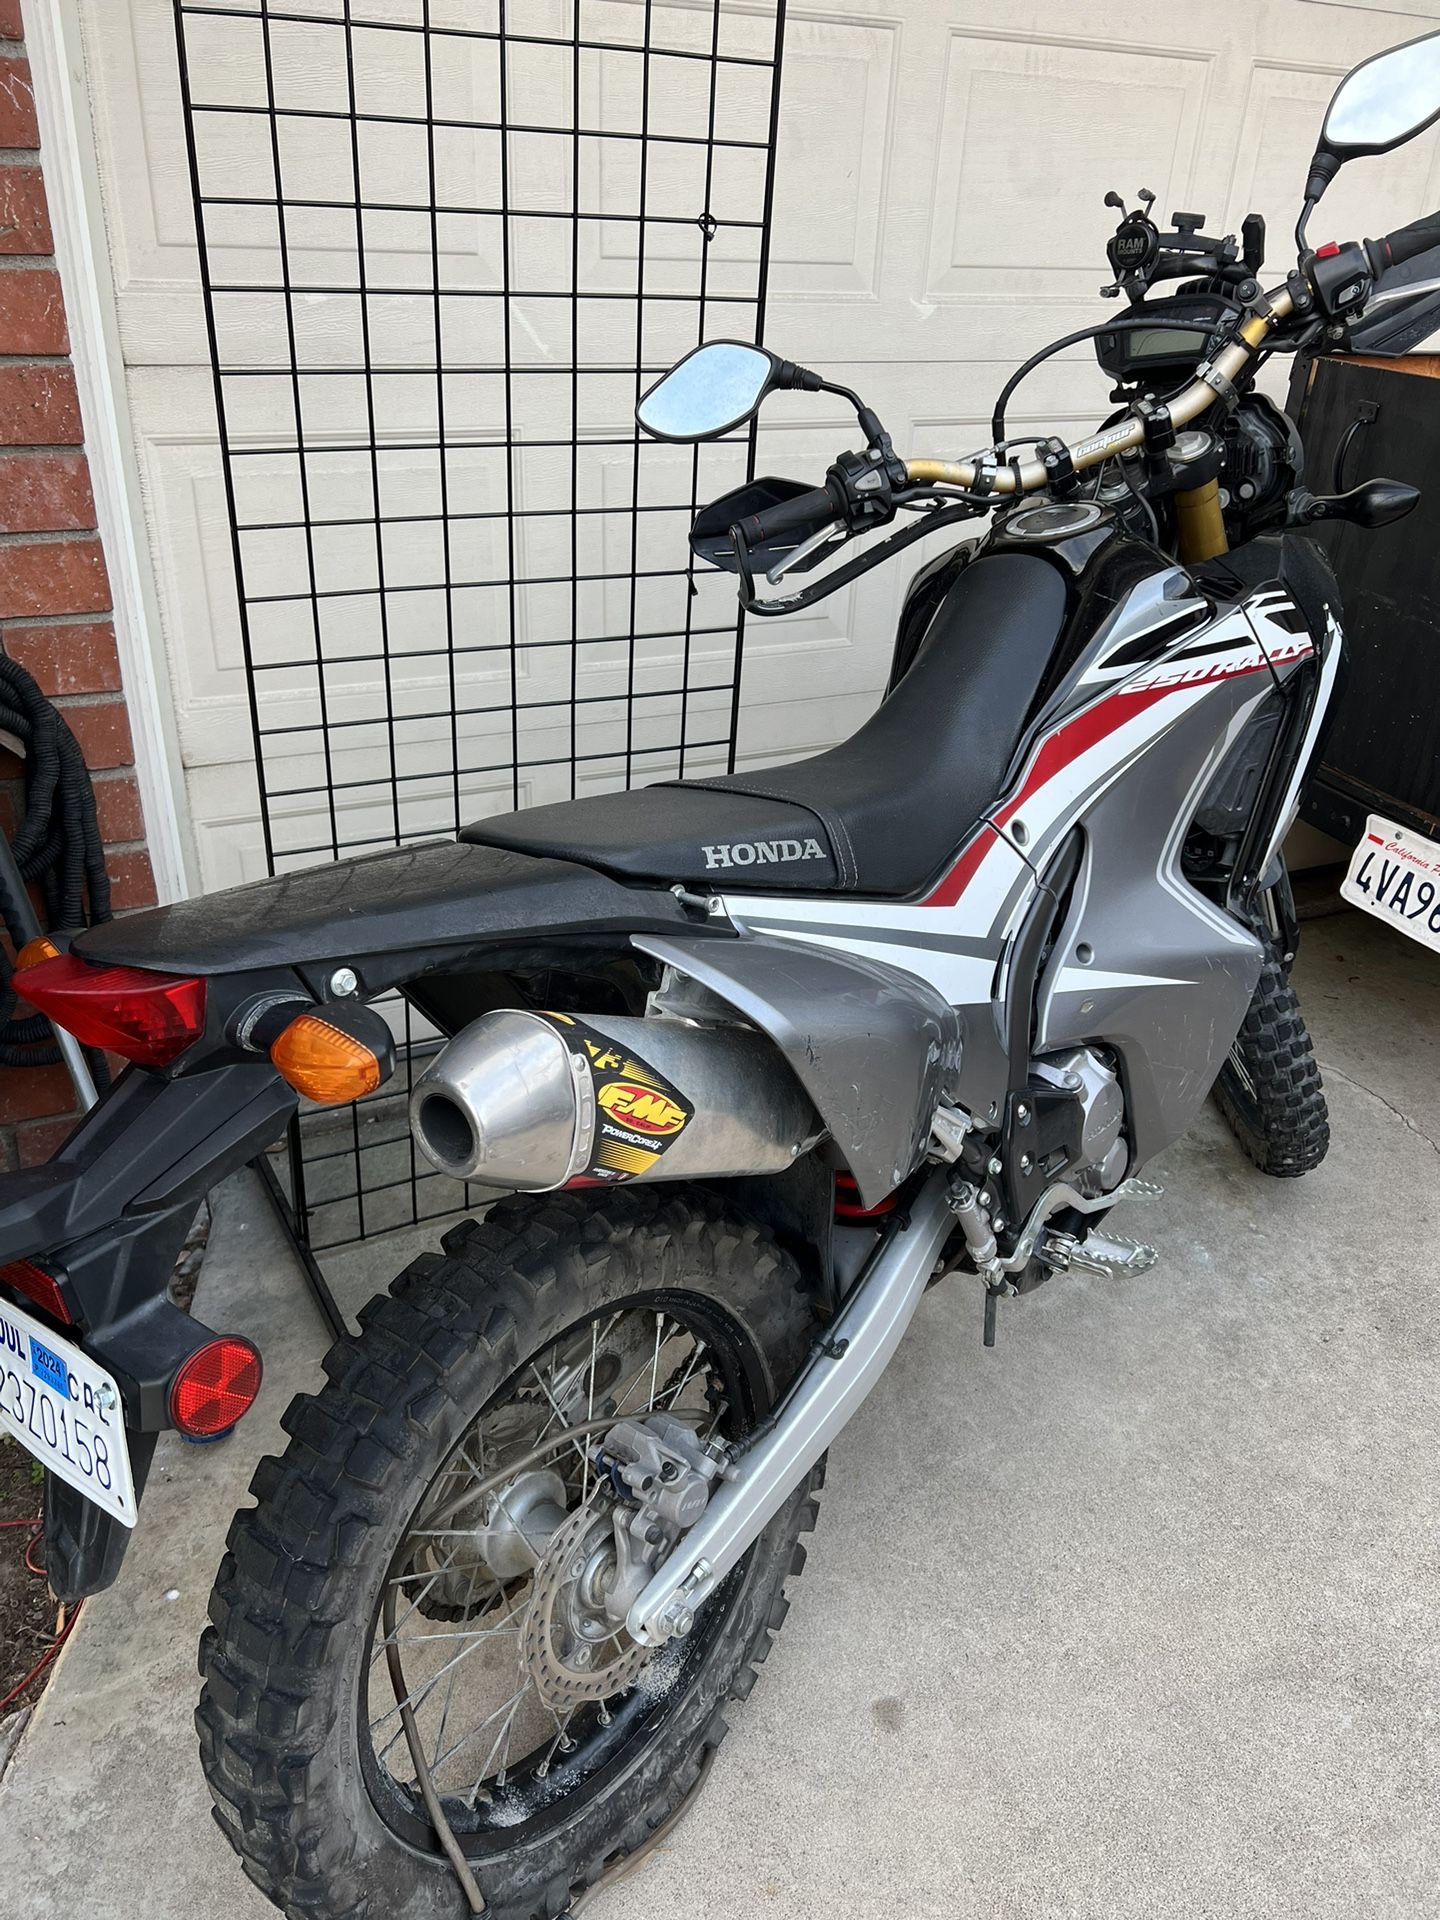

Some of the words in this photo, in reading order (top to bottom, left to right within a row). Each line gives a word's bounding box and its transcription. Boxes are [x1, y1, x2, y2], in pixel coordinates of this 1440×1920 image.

[1117, 237, 1145, 250] RAM
[701, 838, 827, 869] HONDA
[1385, 842, 1430, 869] California
[598, 1086, 687, 1127] FMF
[36, 1346, 62, 1376] 2024
